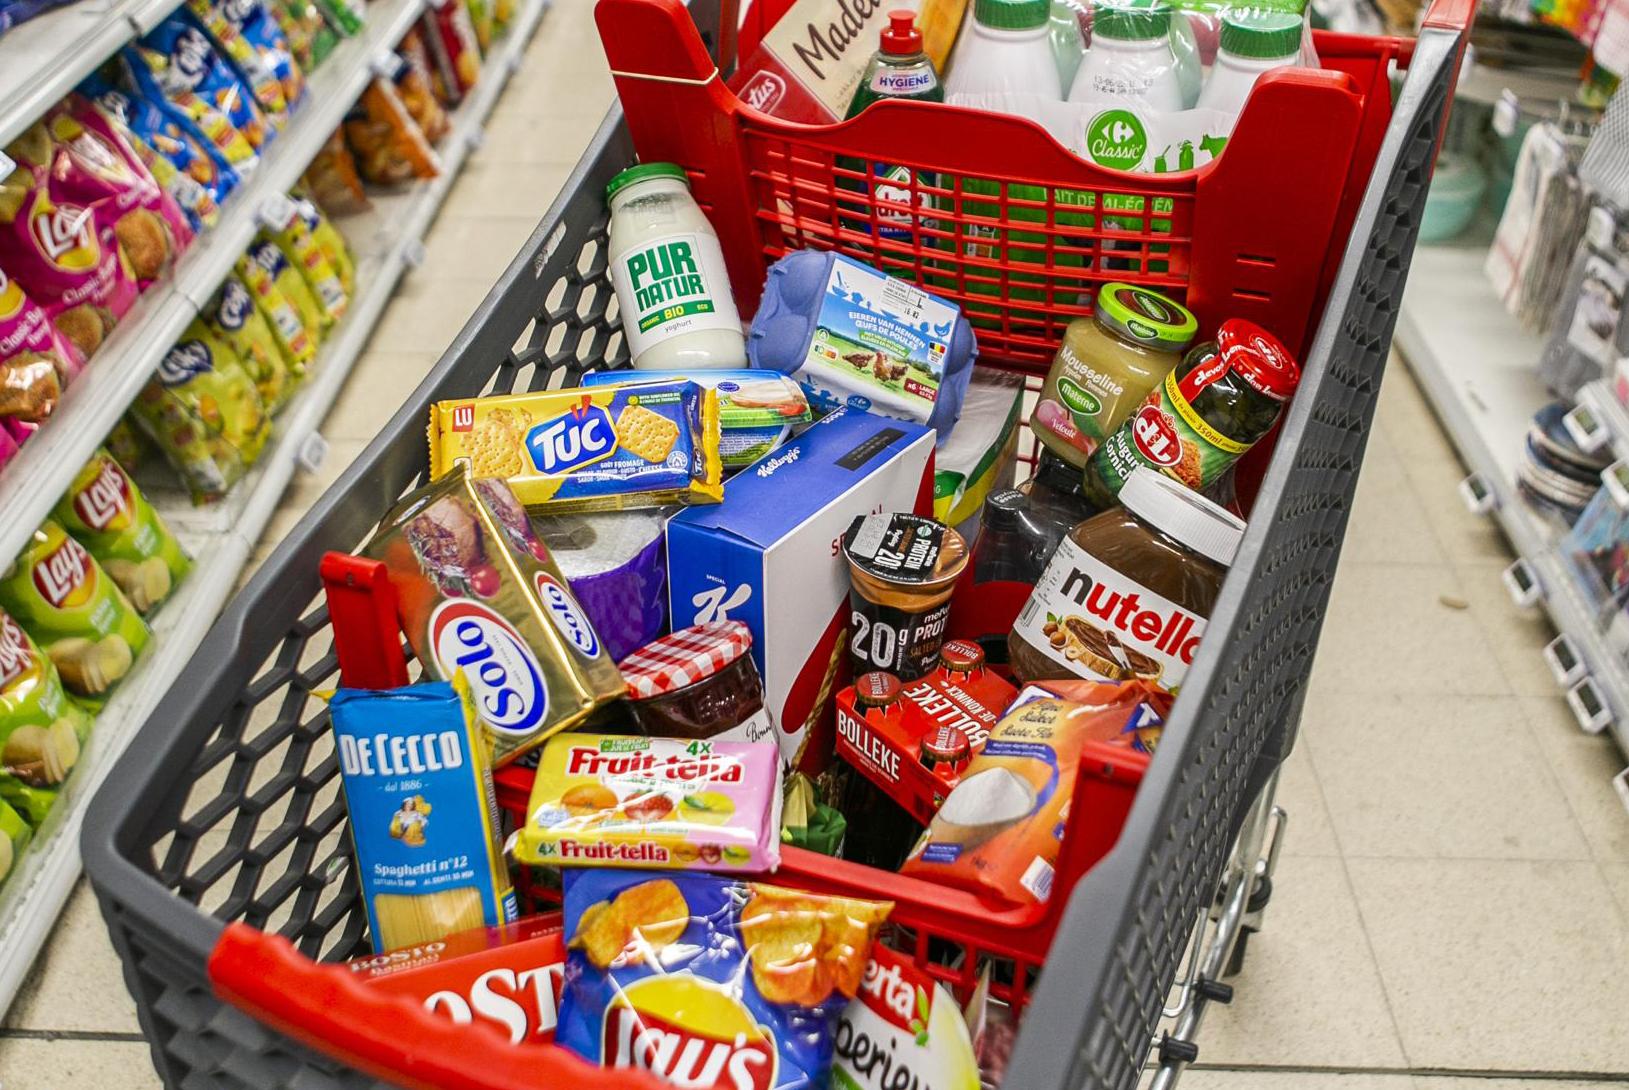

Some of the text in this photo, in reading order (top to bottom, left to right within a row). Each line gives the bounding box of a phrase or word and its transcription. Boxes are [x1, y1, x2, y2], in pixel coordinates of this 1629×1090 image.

[793, 0, 881, 80] Made
[879, 75, 929, 88] HYGIENE
[627, 241, 698, 291] PUR
[635, 273, 705, 313] NATUR
[663, 305, 685, 320] BIO
[664, 319, 692, 332] yoghurt
[848, 311, 878, 326] EIEREN
[878, 317, 894, 330] VAN
[894, 324, 926, 349] HENNEN
[878, 326, 889, 337] DE
[889, 331, 918, 351] POULES
[1060, 345, 1124, 396] Mousseline
[455, 408, 473, 427] LU
[1116, 430, 1144, 468] Augur
[1196, 423, 1224, 445] 350ml
[614, 459, 645, 468] FROMAGE
[757, 446, 800, 478] Kellogg's
[78, 462, 127, 531] Lay's
[706, 574, 726, 585] SPECIAL
[549, 585, 590, 648] Solo
[692, 583, 752, 628] K
[456, 620, 526, 719] Solo
[946, 685, 986, 715] KONINCK
[375, 730, 463, 776] CECCO
[838, 708, 901, 781] BOLLEKE
[384, 779, 423, 792] dal 1886
[559, 839, 668, 861] Fruit-tella
[374, 859, 437, 877] Spaghetti
